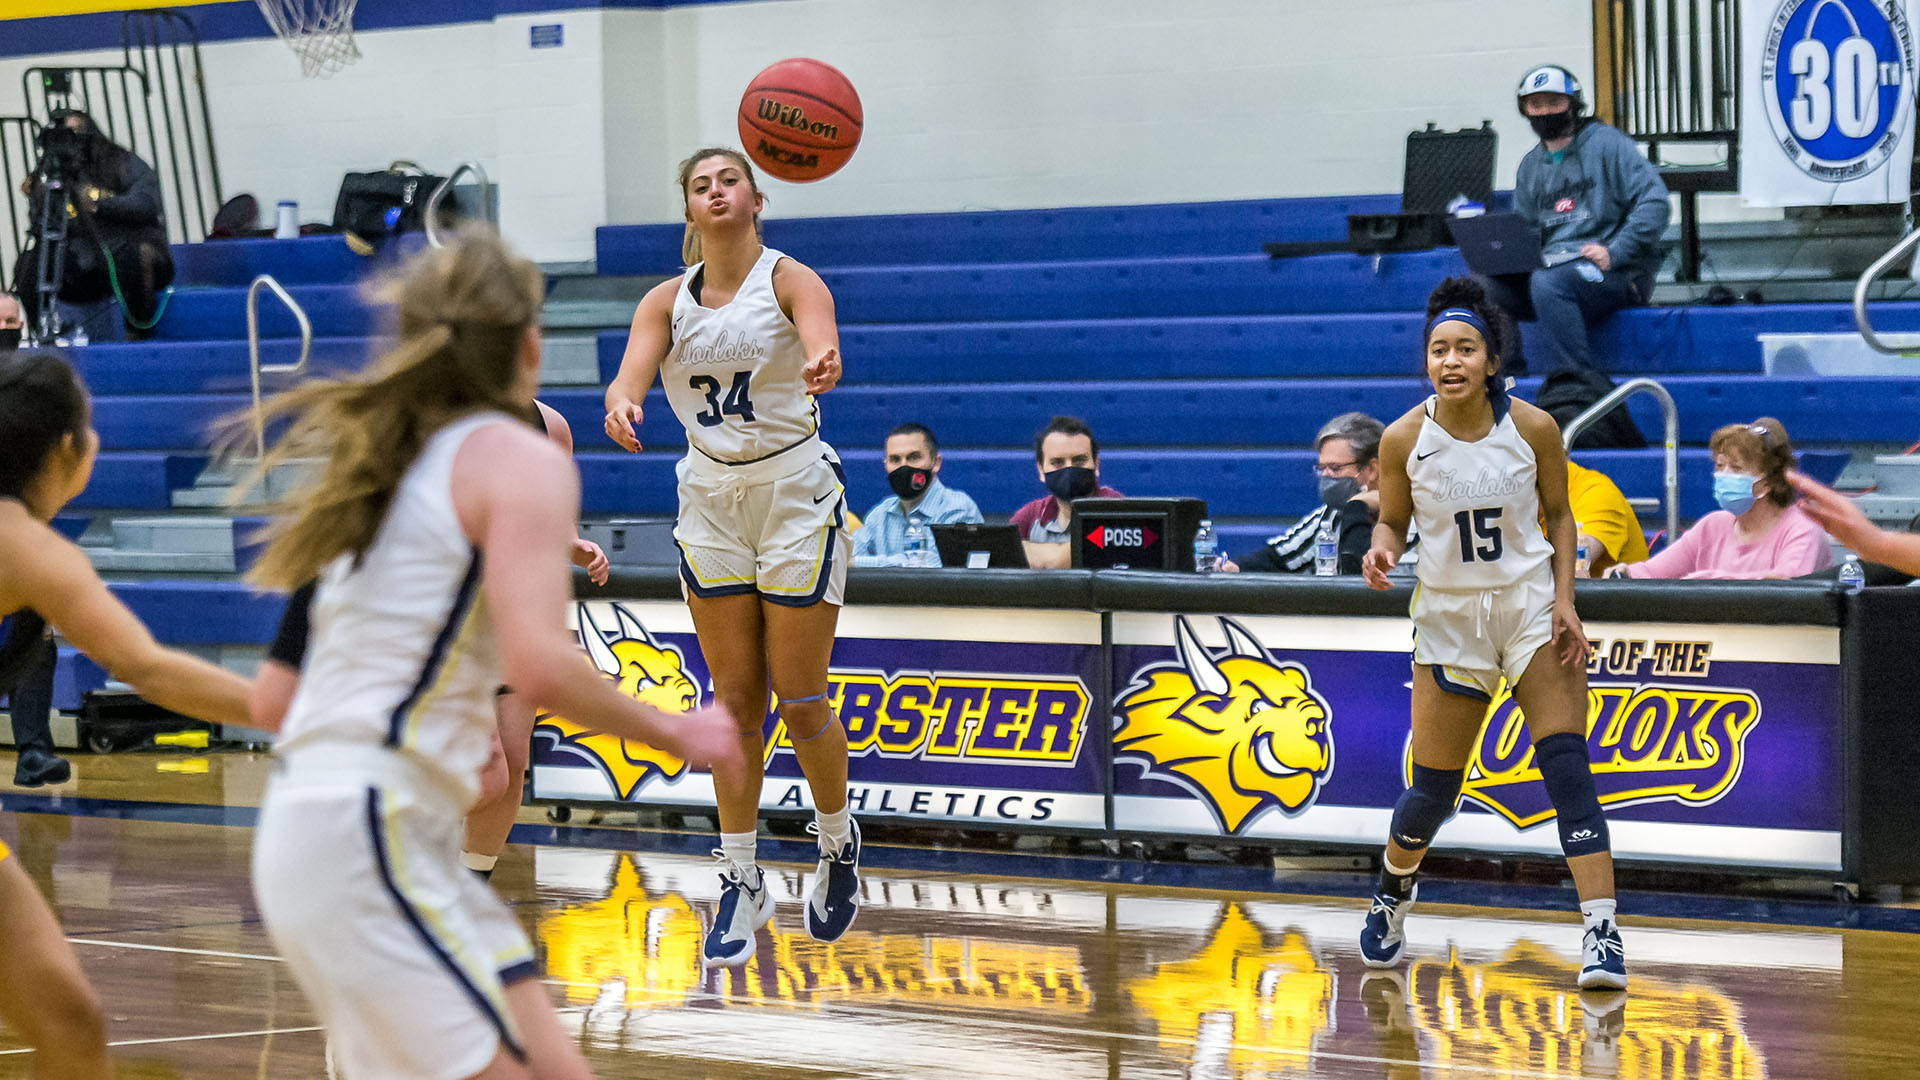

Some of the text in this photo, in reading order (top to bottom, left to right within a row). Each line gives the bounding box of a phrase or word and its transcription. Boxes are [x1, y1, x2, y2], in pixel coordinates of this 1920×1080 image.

[757, 98, 838, 140] Wilson
[689, 370, 757, 428] 34
[1104, 528, 1143, 547] POSS
[1454, 507, 1503, 563] 15
[1607, 639, 1646, 675] OF
[1652, 640, 1711, 677] THE
[778, 784, 1055, 821] AHLETICS
